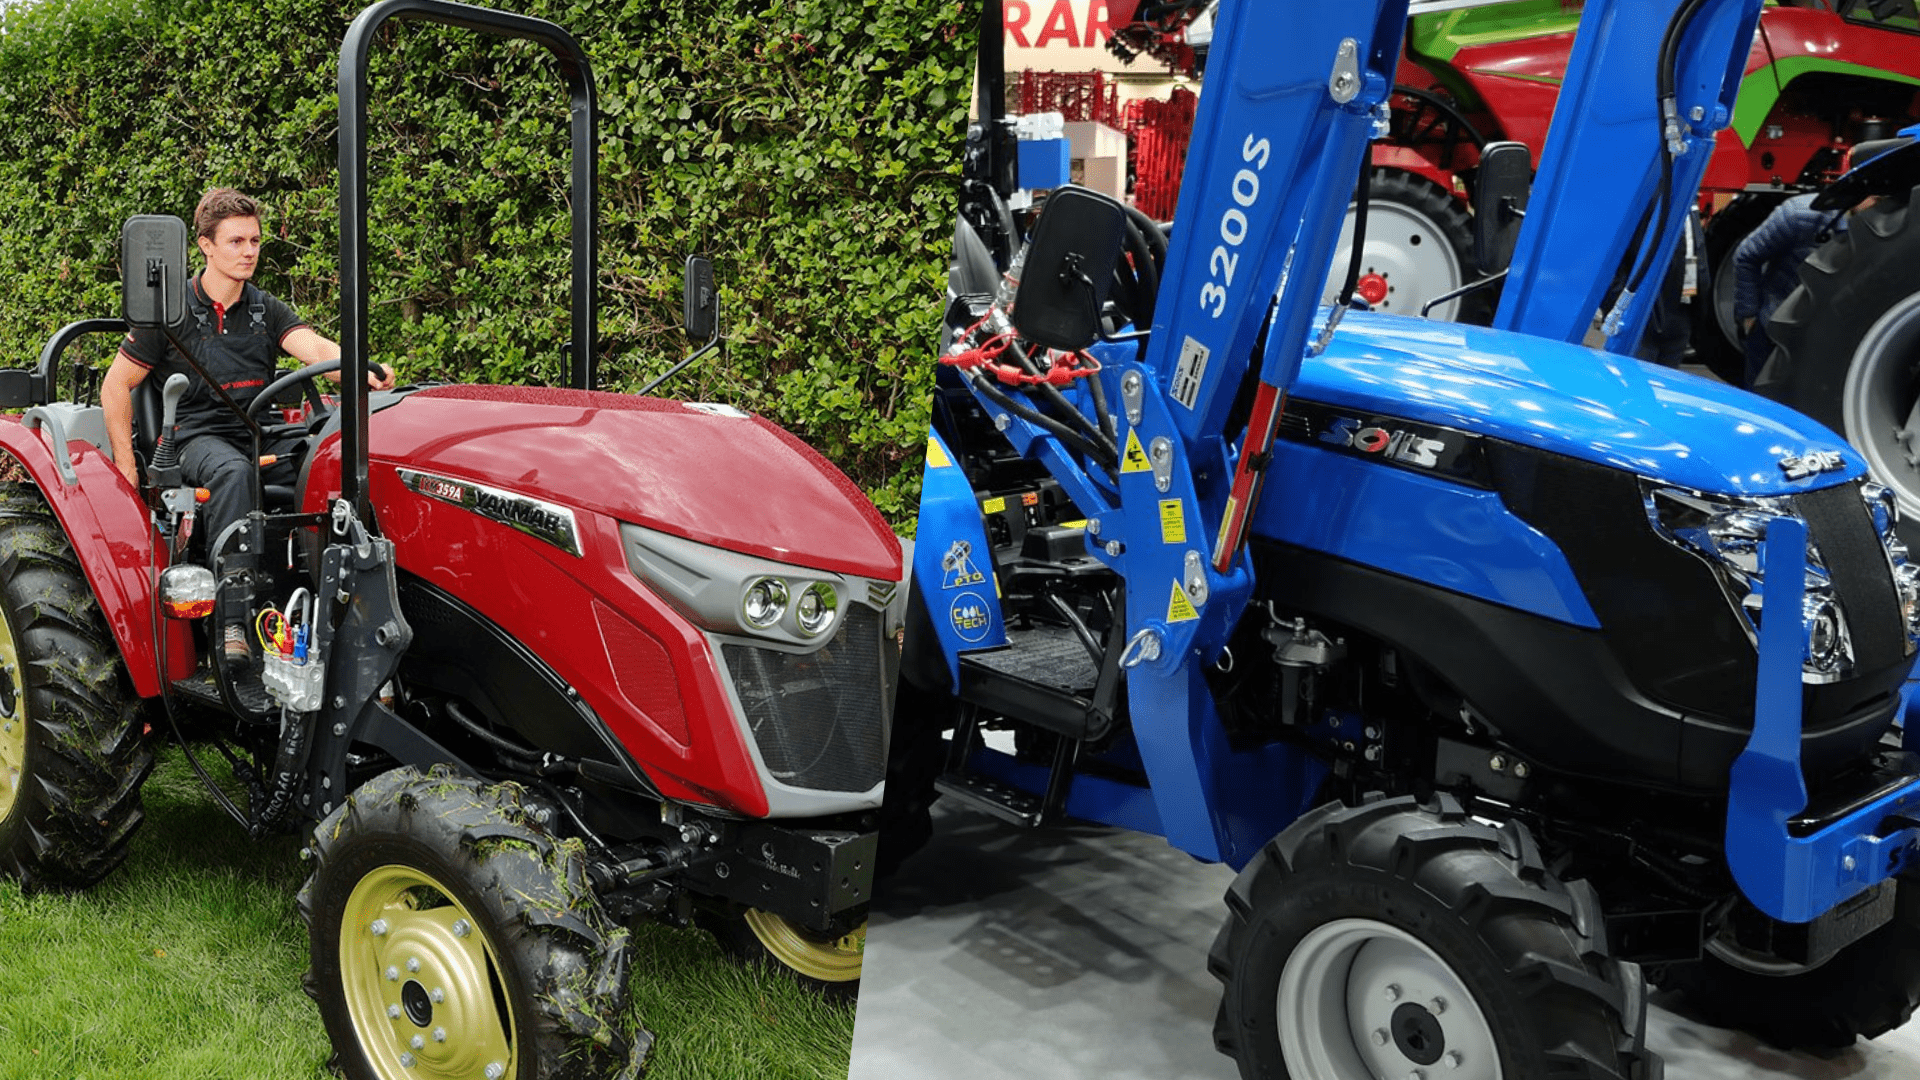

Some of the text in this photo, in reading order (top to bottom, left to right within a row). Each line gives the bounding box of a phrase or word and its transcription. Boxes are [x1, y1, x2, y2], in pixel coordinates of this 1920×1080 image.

[1200, 132, 1270, 319] 3200S
[954, 572, 982, 587] PTO
[955, 616, 987, 630] TECH
